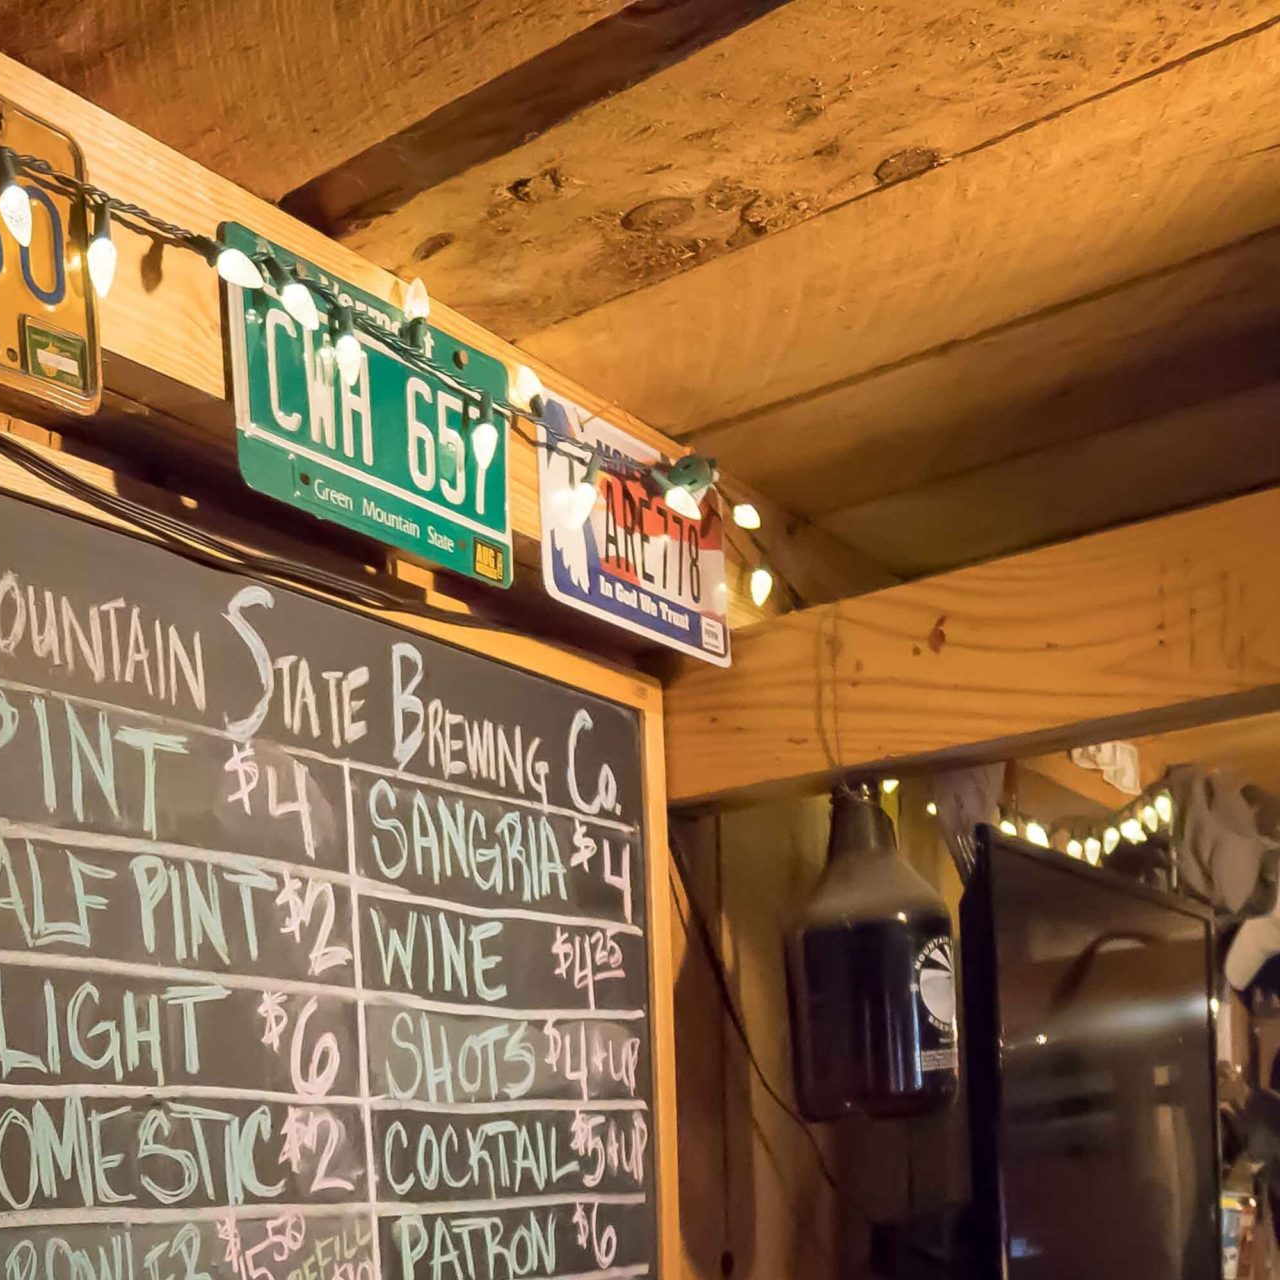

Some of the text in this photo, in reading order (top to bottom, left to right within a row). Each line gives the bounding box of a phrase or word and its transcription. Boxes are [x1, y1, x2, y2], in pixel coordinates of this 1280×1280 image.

[314, 479, 456, 554] Green Mountain State
[598, 574, 614, 599] In
[659, 601, 691, 632] Trust
[219, 584, 371, 750] STATE
[390, 641, 550, 812] BREWING
[223, 740, 317, 861] $4
[368, 777, 634, 926] SANGRIA $4
[127, 854, 280, 966] PINT
[274, 867, 355, 977] $2
[369, 906, 509, 1003] WINE
[256, 987, 342, 1101] $6
[384, 1011, 537, 1105] SHOTS
[277, 1103, 357, 1195] $2
[384, 1119, 581, 1201] COCKTAIL
[572, 1200, 618, 1270] $6
